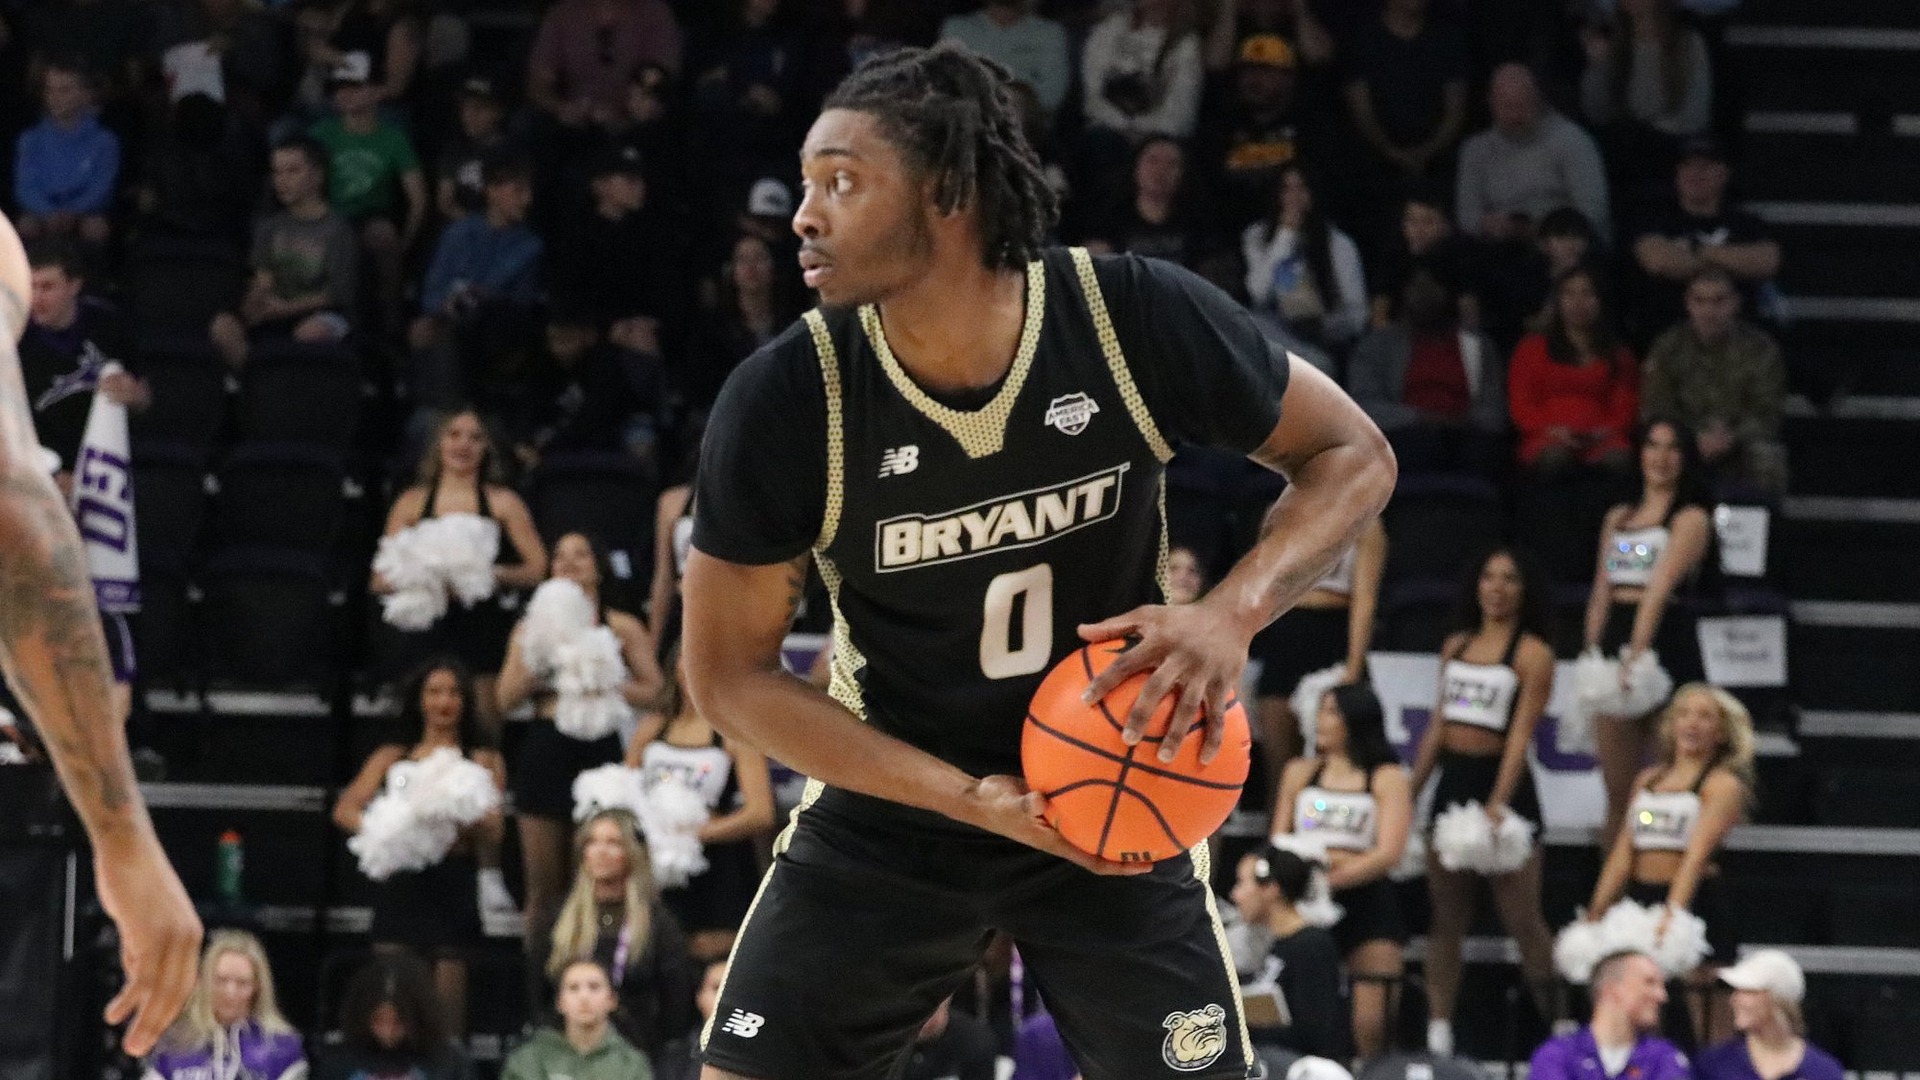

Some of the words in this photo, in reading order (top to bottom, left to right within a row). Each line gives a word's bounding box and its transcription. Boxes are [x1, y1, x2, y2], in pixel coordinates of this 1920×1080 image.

[1059, 411, 1087, 426] EAST
[882, 475, 1116, 567] BRYANT
[979, 562, 1054, 680] 0
